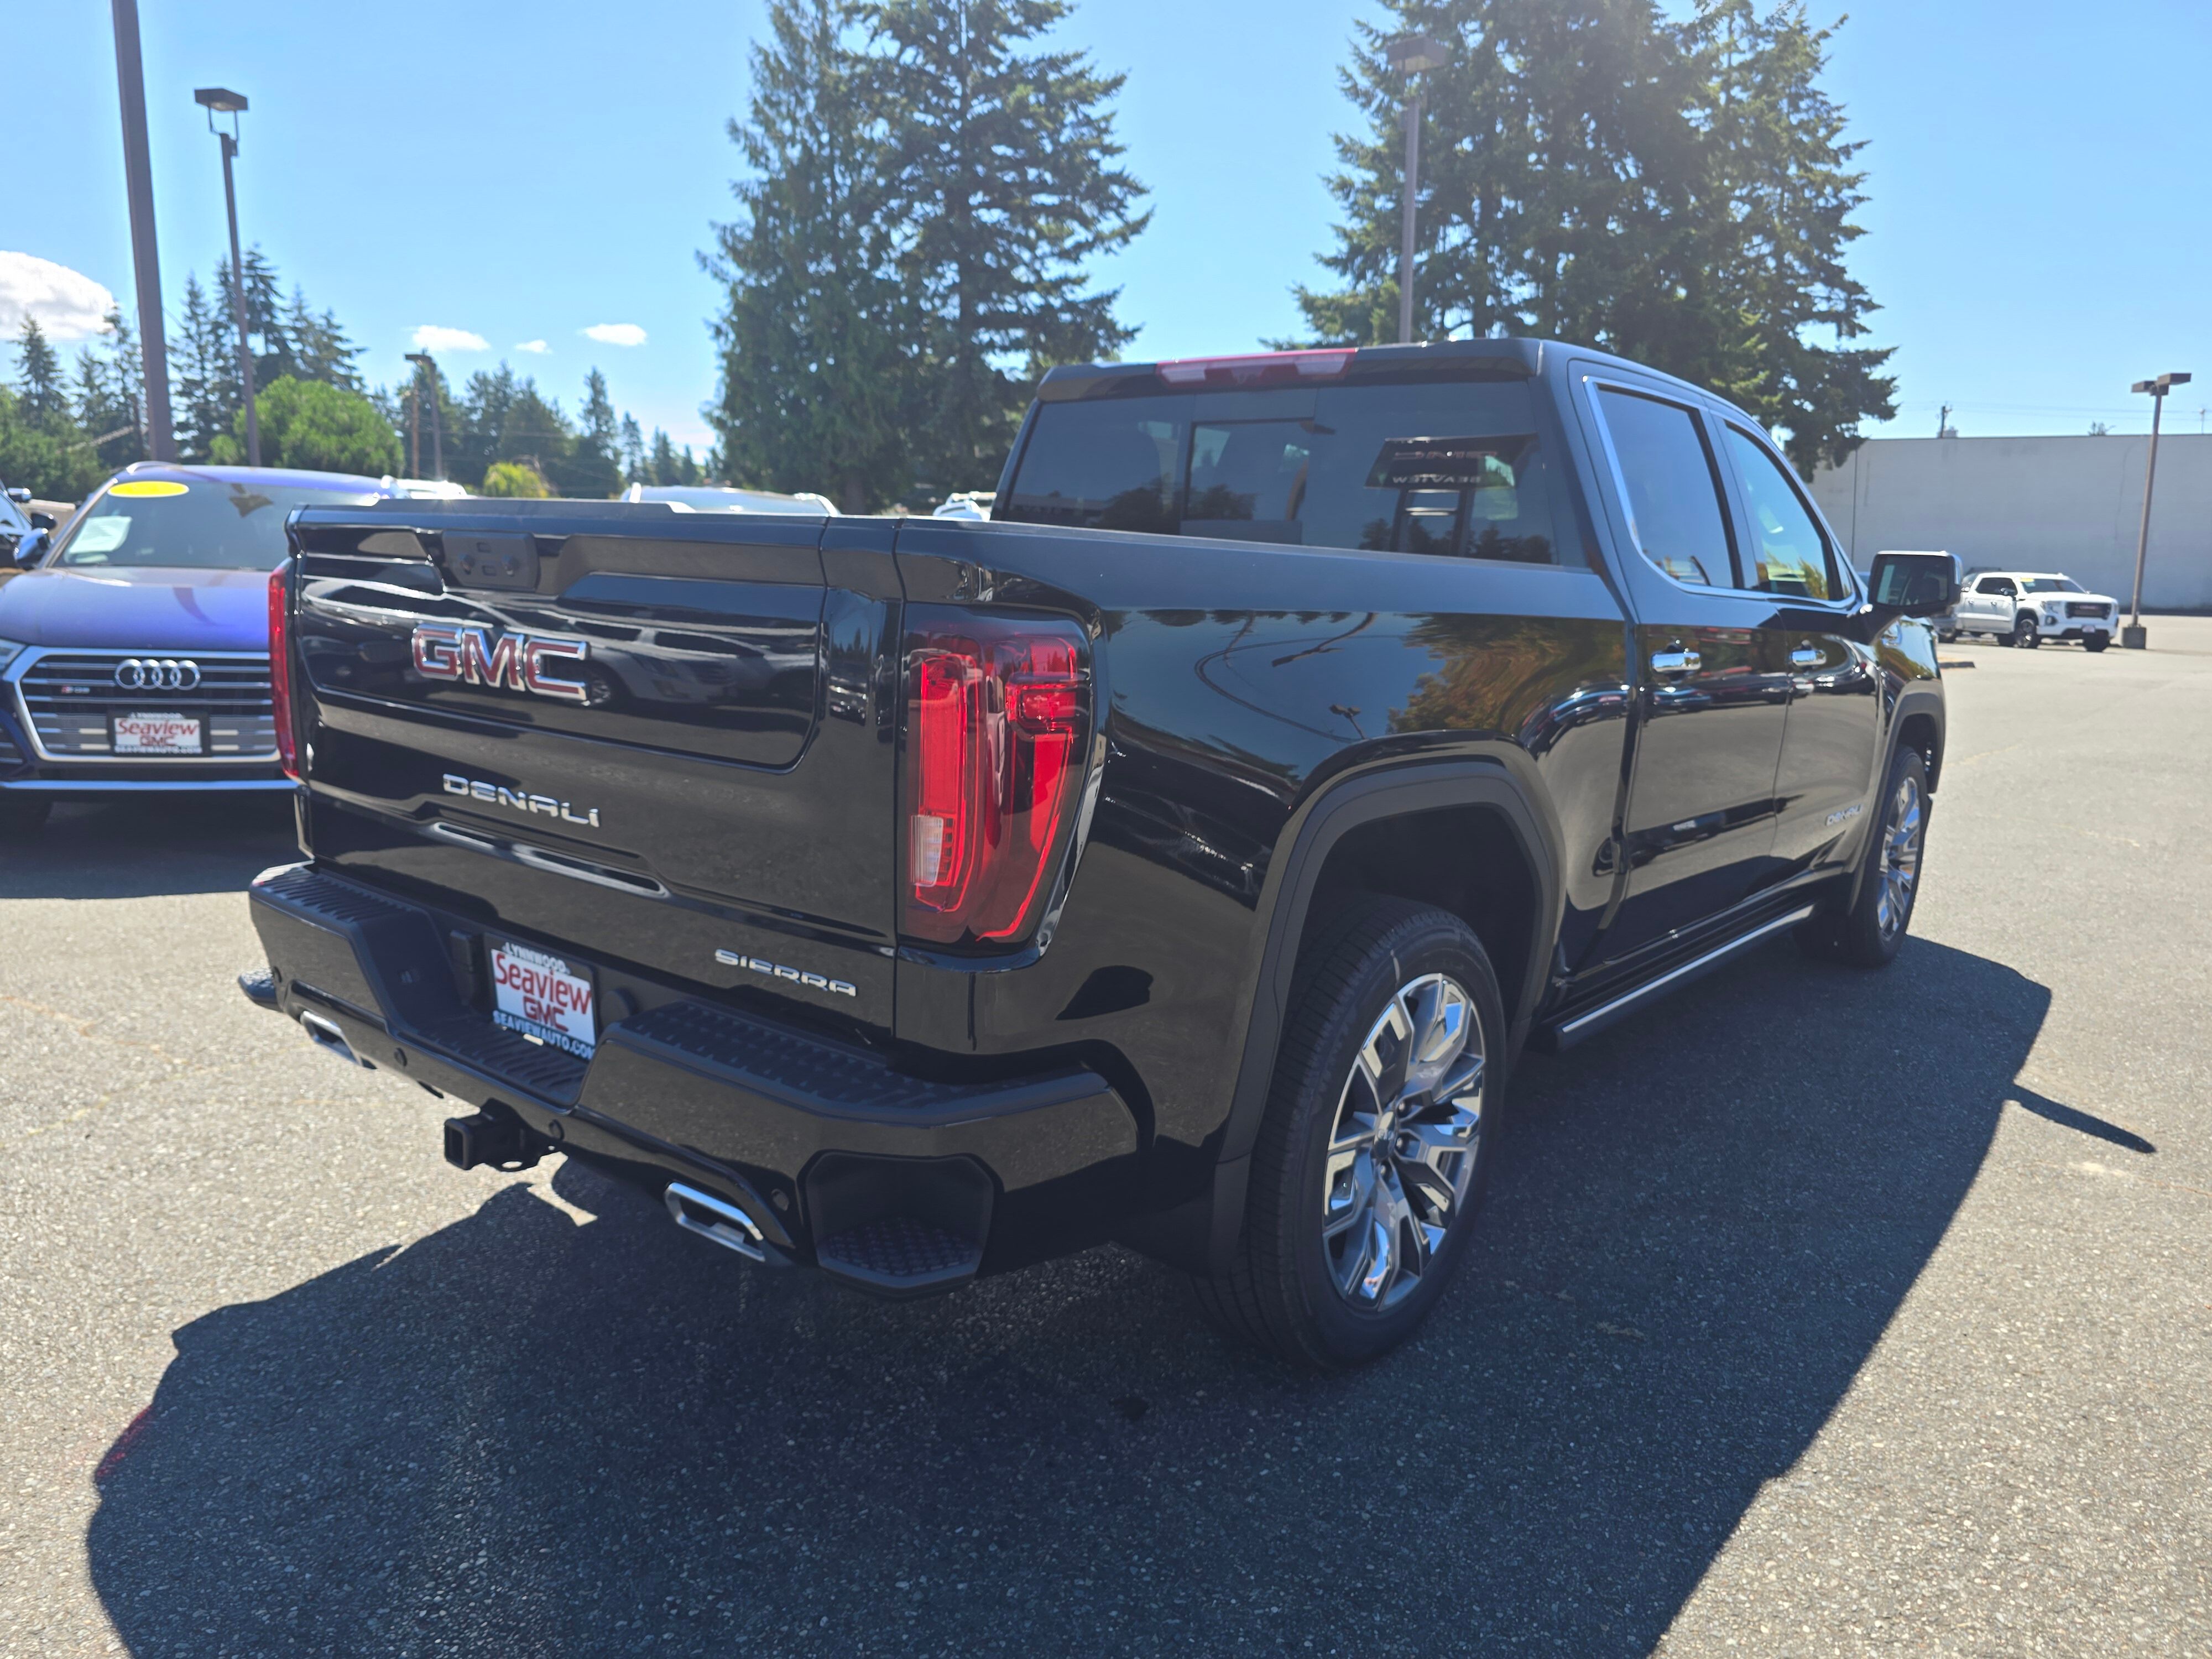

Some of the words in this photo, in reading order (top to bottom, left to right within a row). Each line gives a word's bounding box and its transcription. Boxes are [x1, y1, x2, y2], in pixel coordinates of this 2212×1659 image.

[412, 623, 590, 702] GMC
[116, 719, 200, 735] Seaview
[140, 736, 176, 747] GMC
[443, 774, 599, 828] DENALI
[496, 952, 592, 1015] Seaview
[715, 949, 857, 997] SIERRA
[523, 997, 568, 1032] GMC
